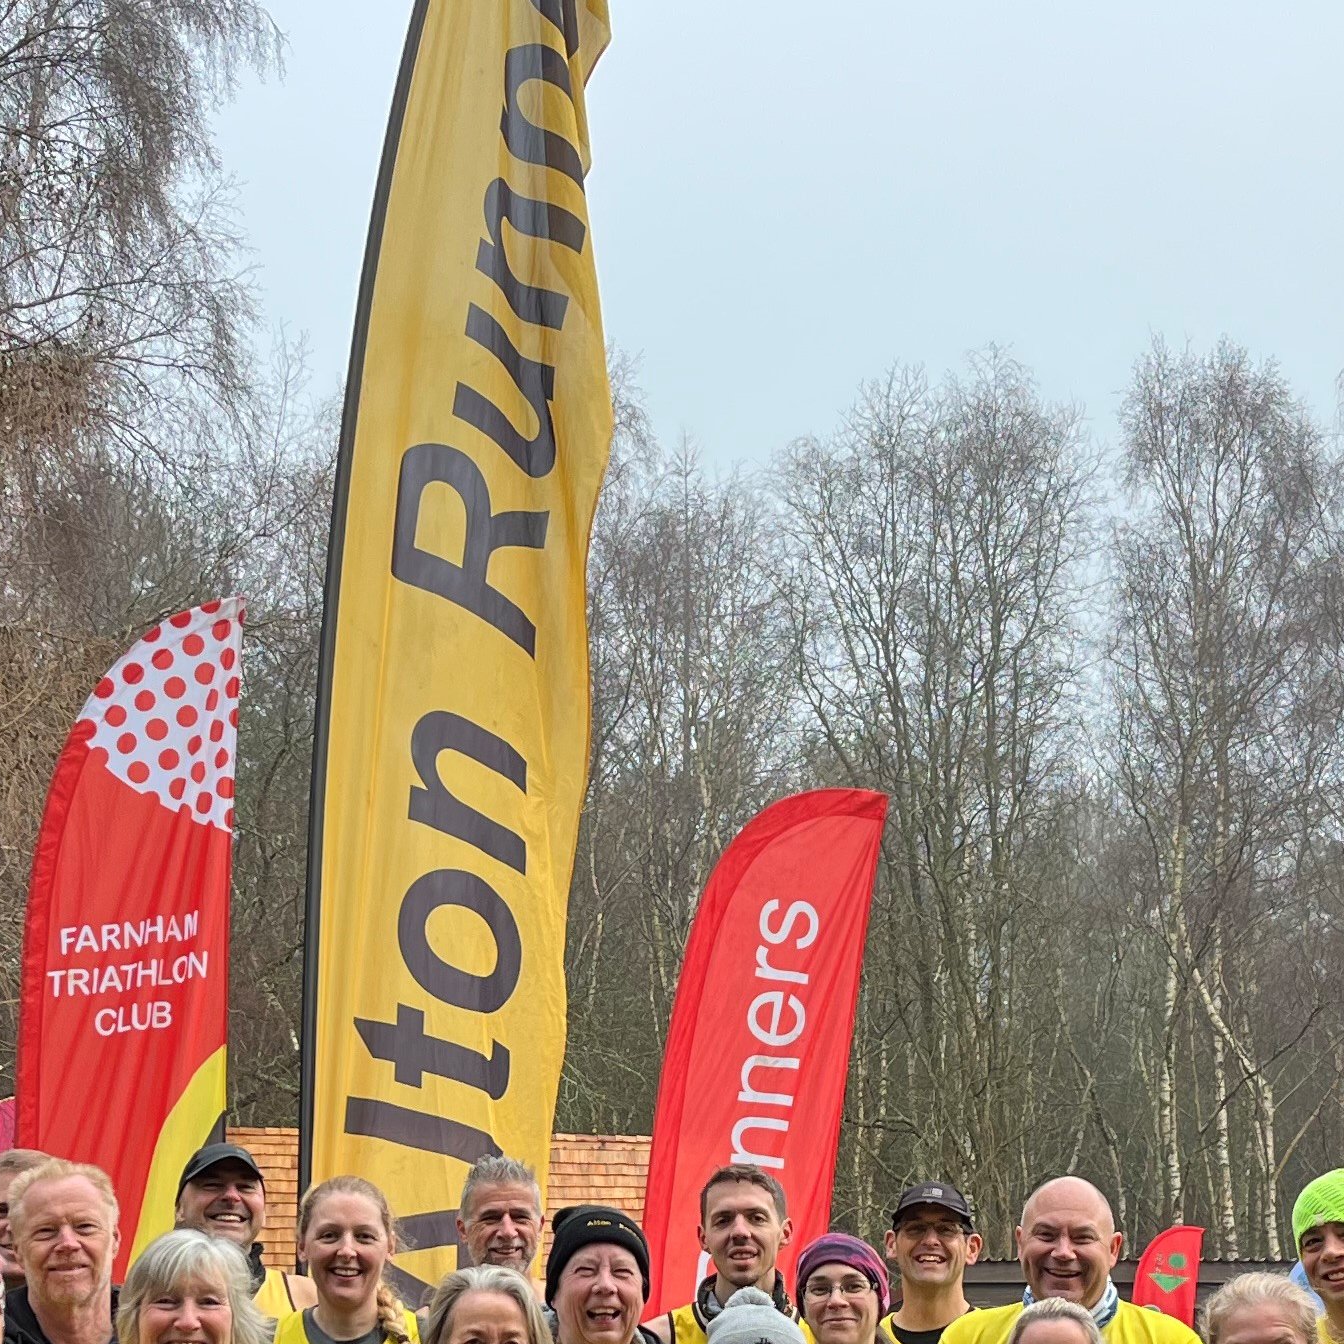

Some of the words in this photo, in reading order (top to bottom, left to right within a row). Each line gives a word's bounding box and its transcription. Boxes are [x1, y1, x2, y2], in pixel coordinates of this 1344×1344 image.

[60, 910, 198, 955] FARNHAM
[47, 951, 208, 997] TRIATHLON
[94, 1001, 172, 1036] CLUB
